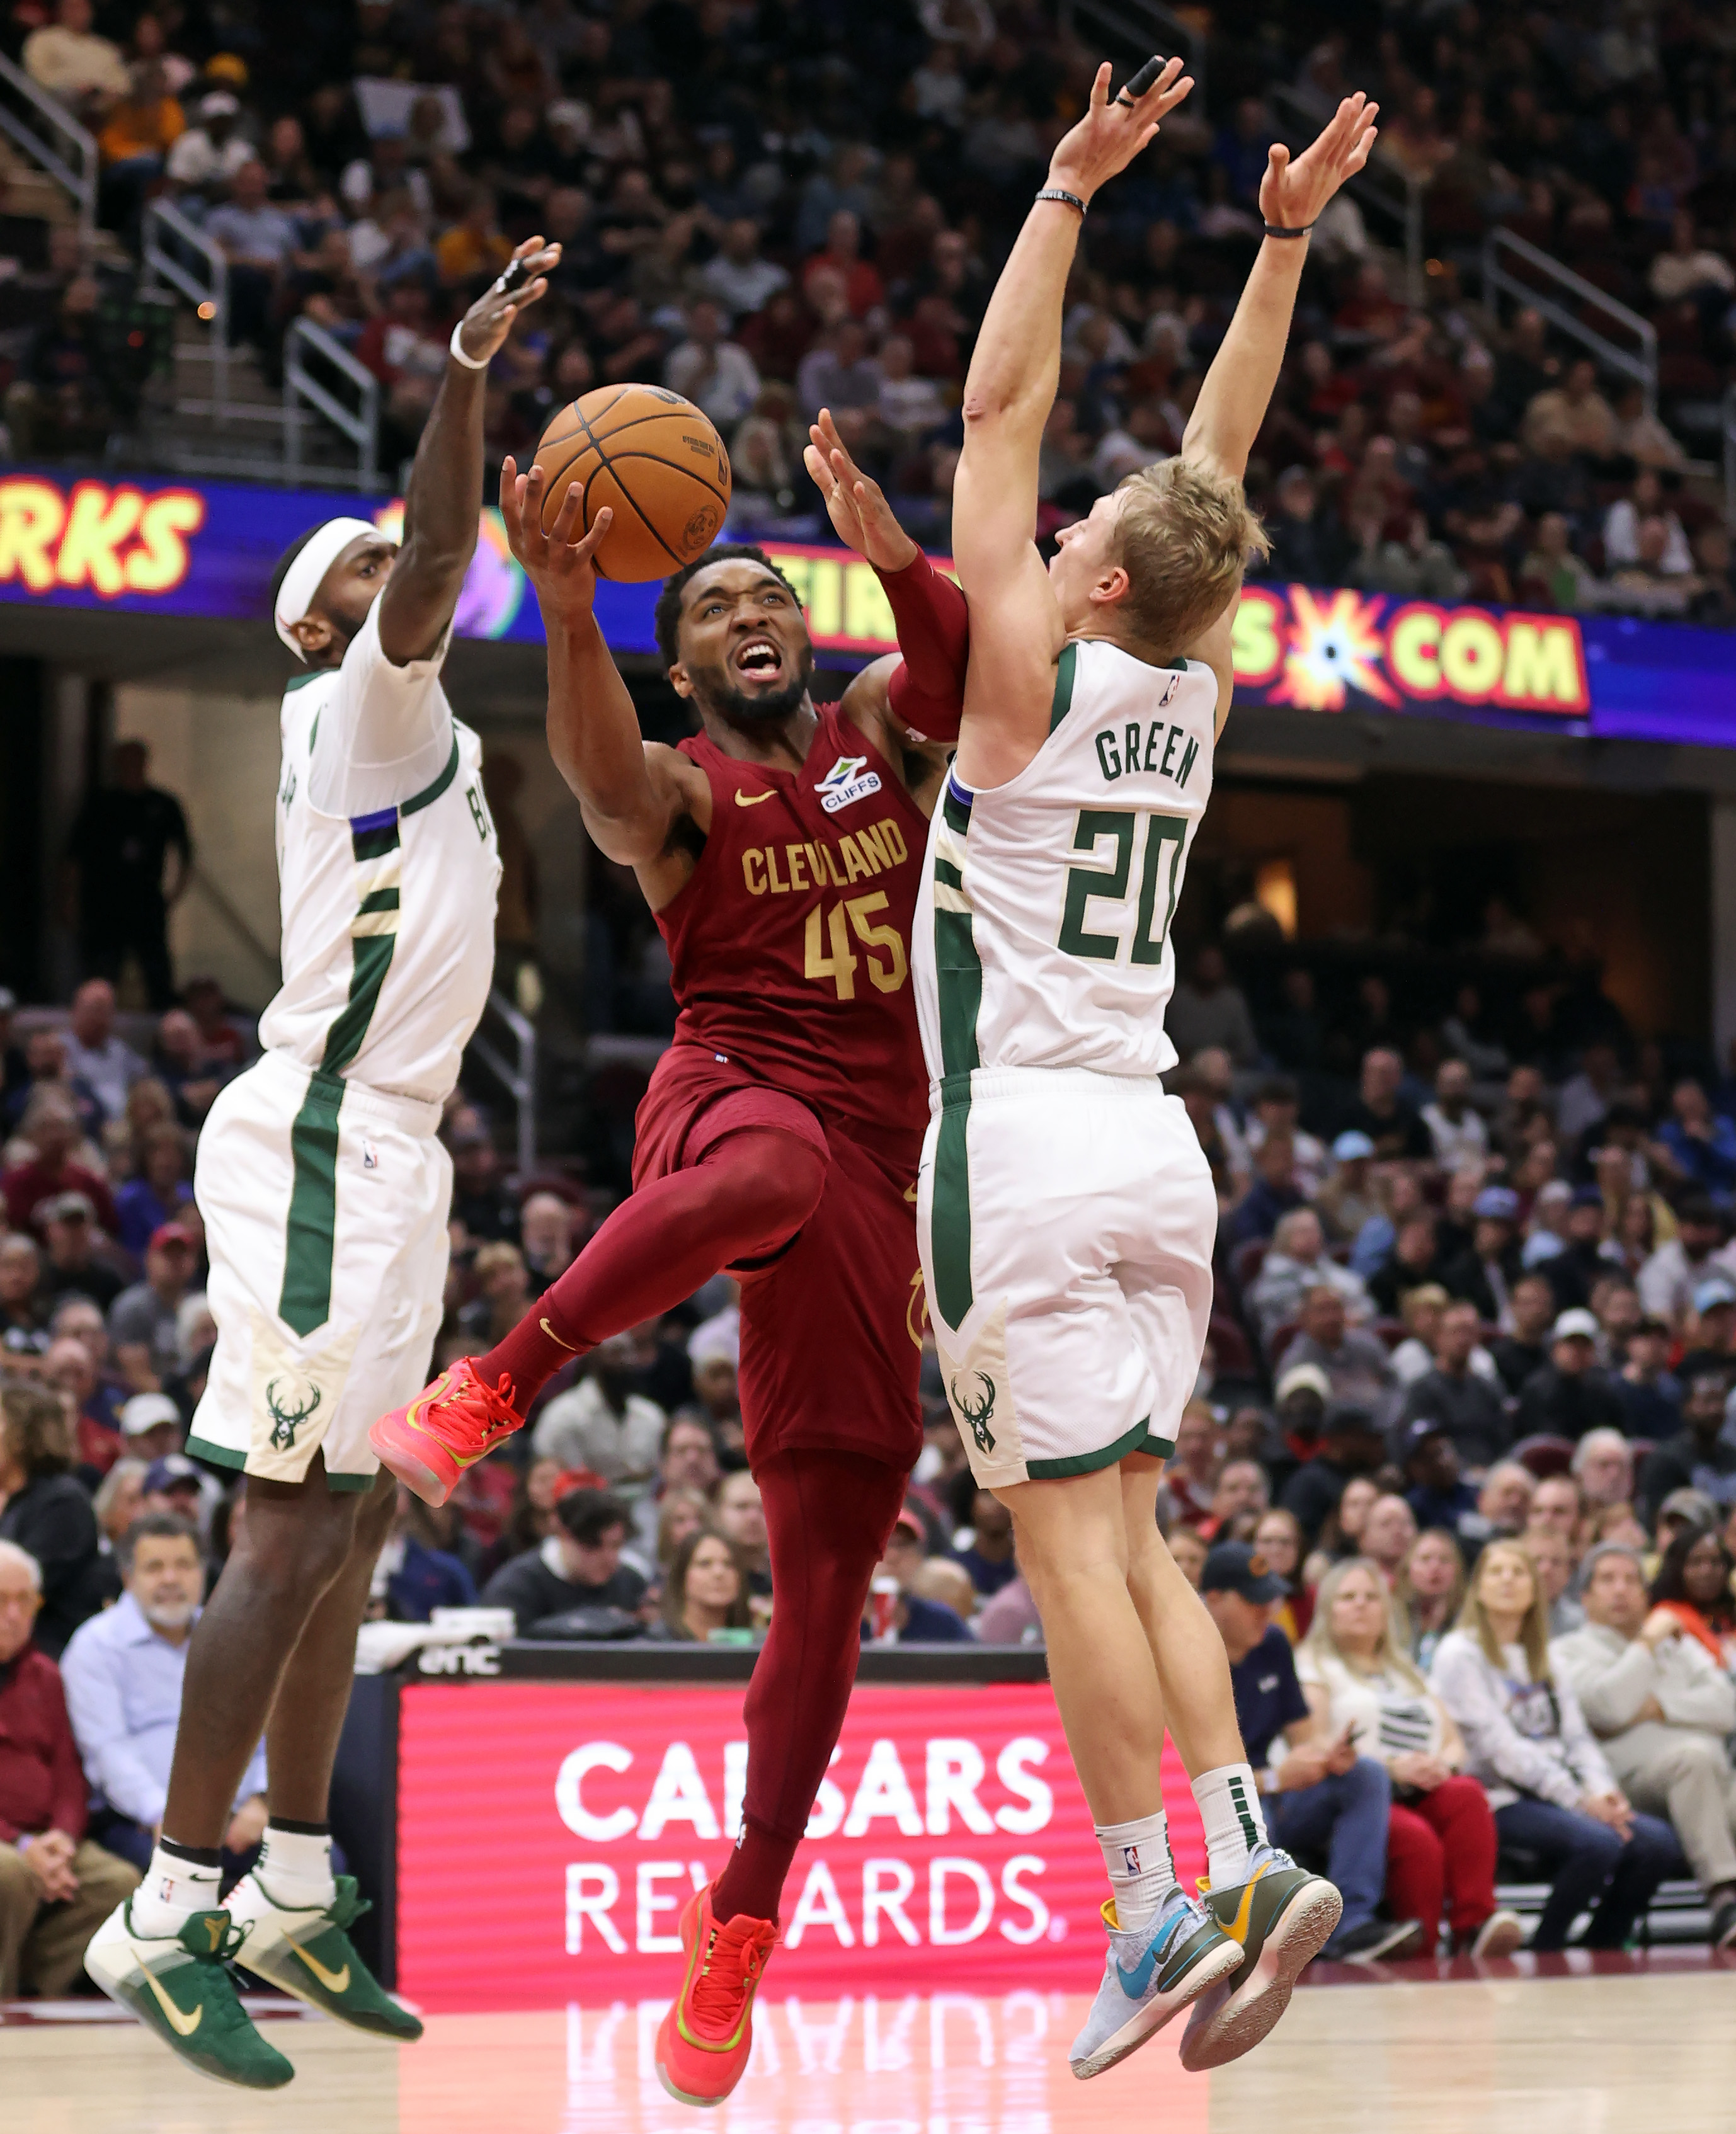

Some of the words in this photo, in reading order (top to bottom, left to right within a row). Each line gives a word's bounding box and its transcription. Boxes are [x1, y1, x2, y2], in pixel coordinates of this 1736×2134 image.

[0, 482, 203, 594] RKS
[1390, 609, 1584, 705] COM
[825, 776, 879, 809] CLIFFS
[1095, 721, 1200, 790] GREEN
[741, 818, 908, 896] CLEVLAND
[1055, 807, 1191, 968] 20
[804, 889, 908, 1001] 45
[564, 1853, 1051, 1955] REARDS
